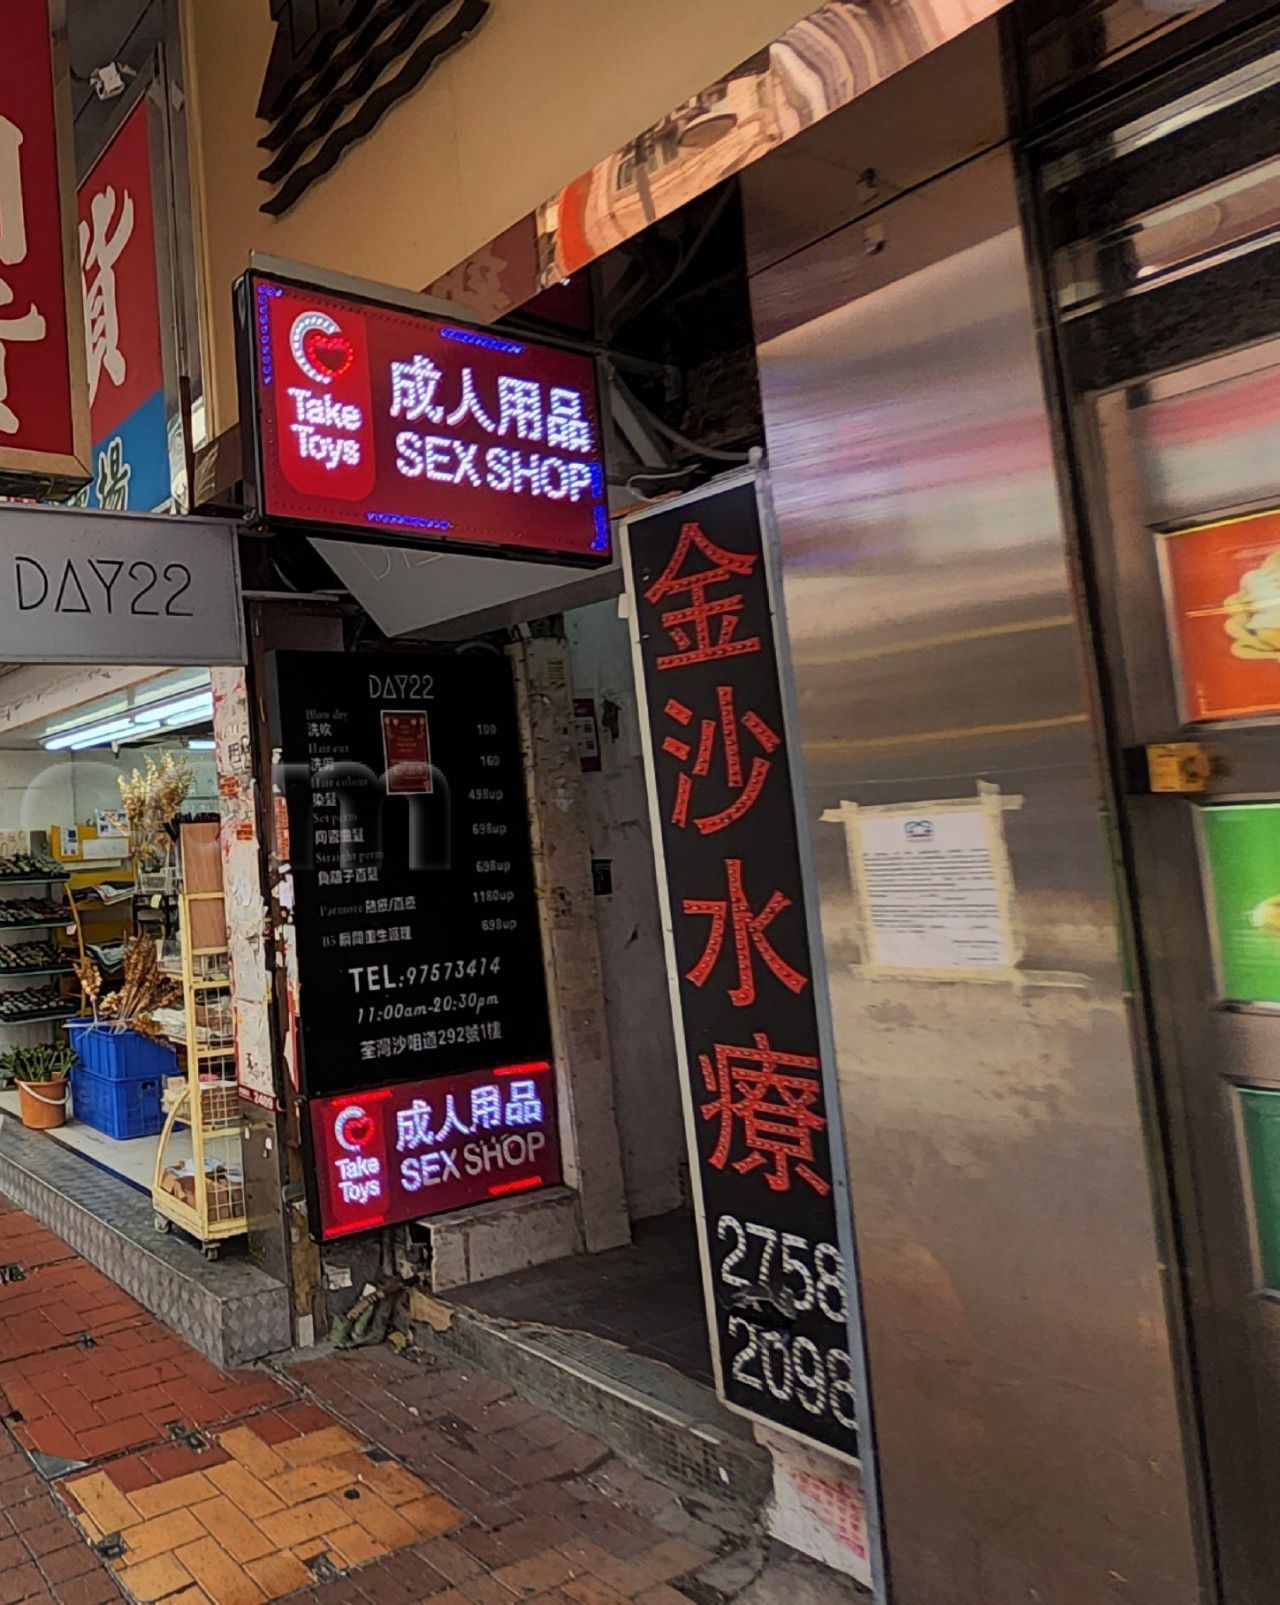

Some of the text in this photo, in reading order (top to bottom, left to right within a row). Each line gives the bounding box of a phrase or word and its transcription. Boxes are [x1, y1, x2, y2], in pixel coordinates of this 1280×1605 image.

[287, 386, 363, 431] Take
[387, 353, 593, 454] 成人用品
[291, 423, 361, 471] Toys
[395, 432, 595, 503] SEX SHOP
[14, 555, 194, 617] DAY22
[369, 674, 434, 699] DAY22
[645, 522, 830, 1196] 金沙水療
[357, 992, 499, 1025] 11:00am-20:30pm
[360, 1021, 502, 1061] 荃灣沙咀道292號1樓
[395, 1079, 545, 1151] 成人用品
[335, 1156, 380, 1181] Take
[400, 1131, 546, 1192] SEX SHOP
[338, 1180, 382, 1206] Toys
[717, 1214, 848, 1324] 2758
[727, 1314, 860, 1431] 2098
